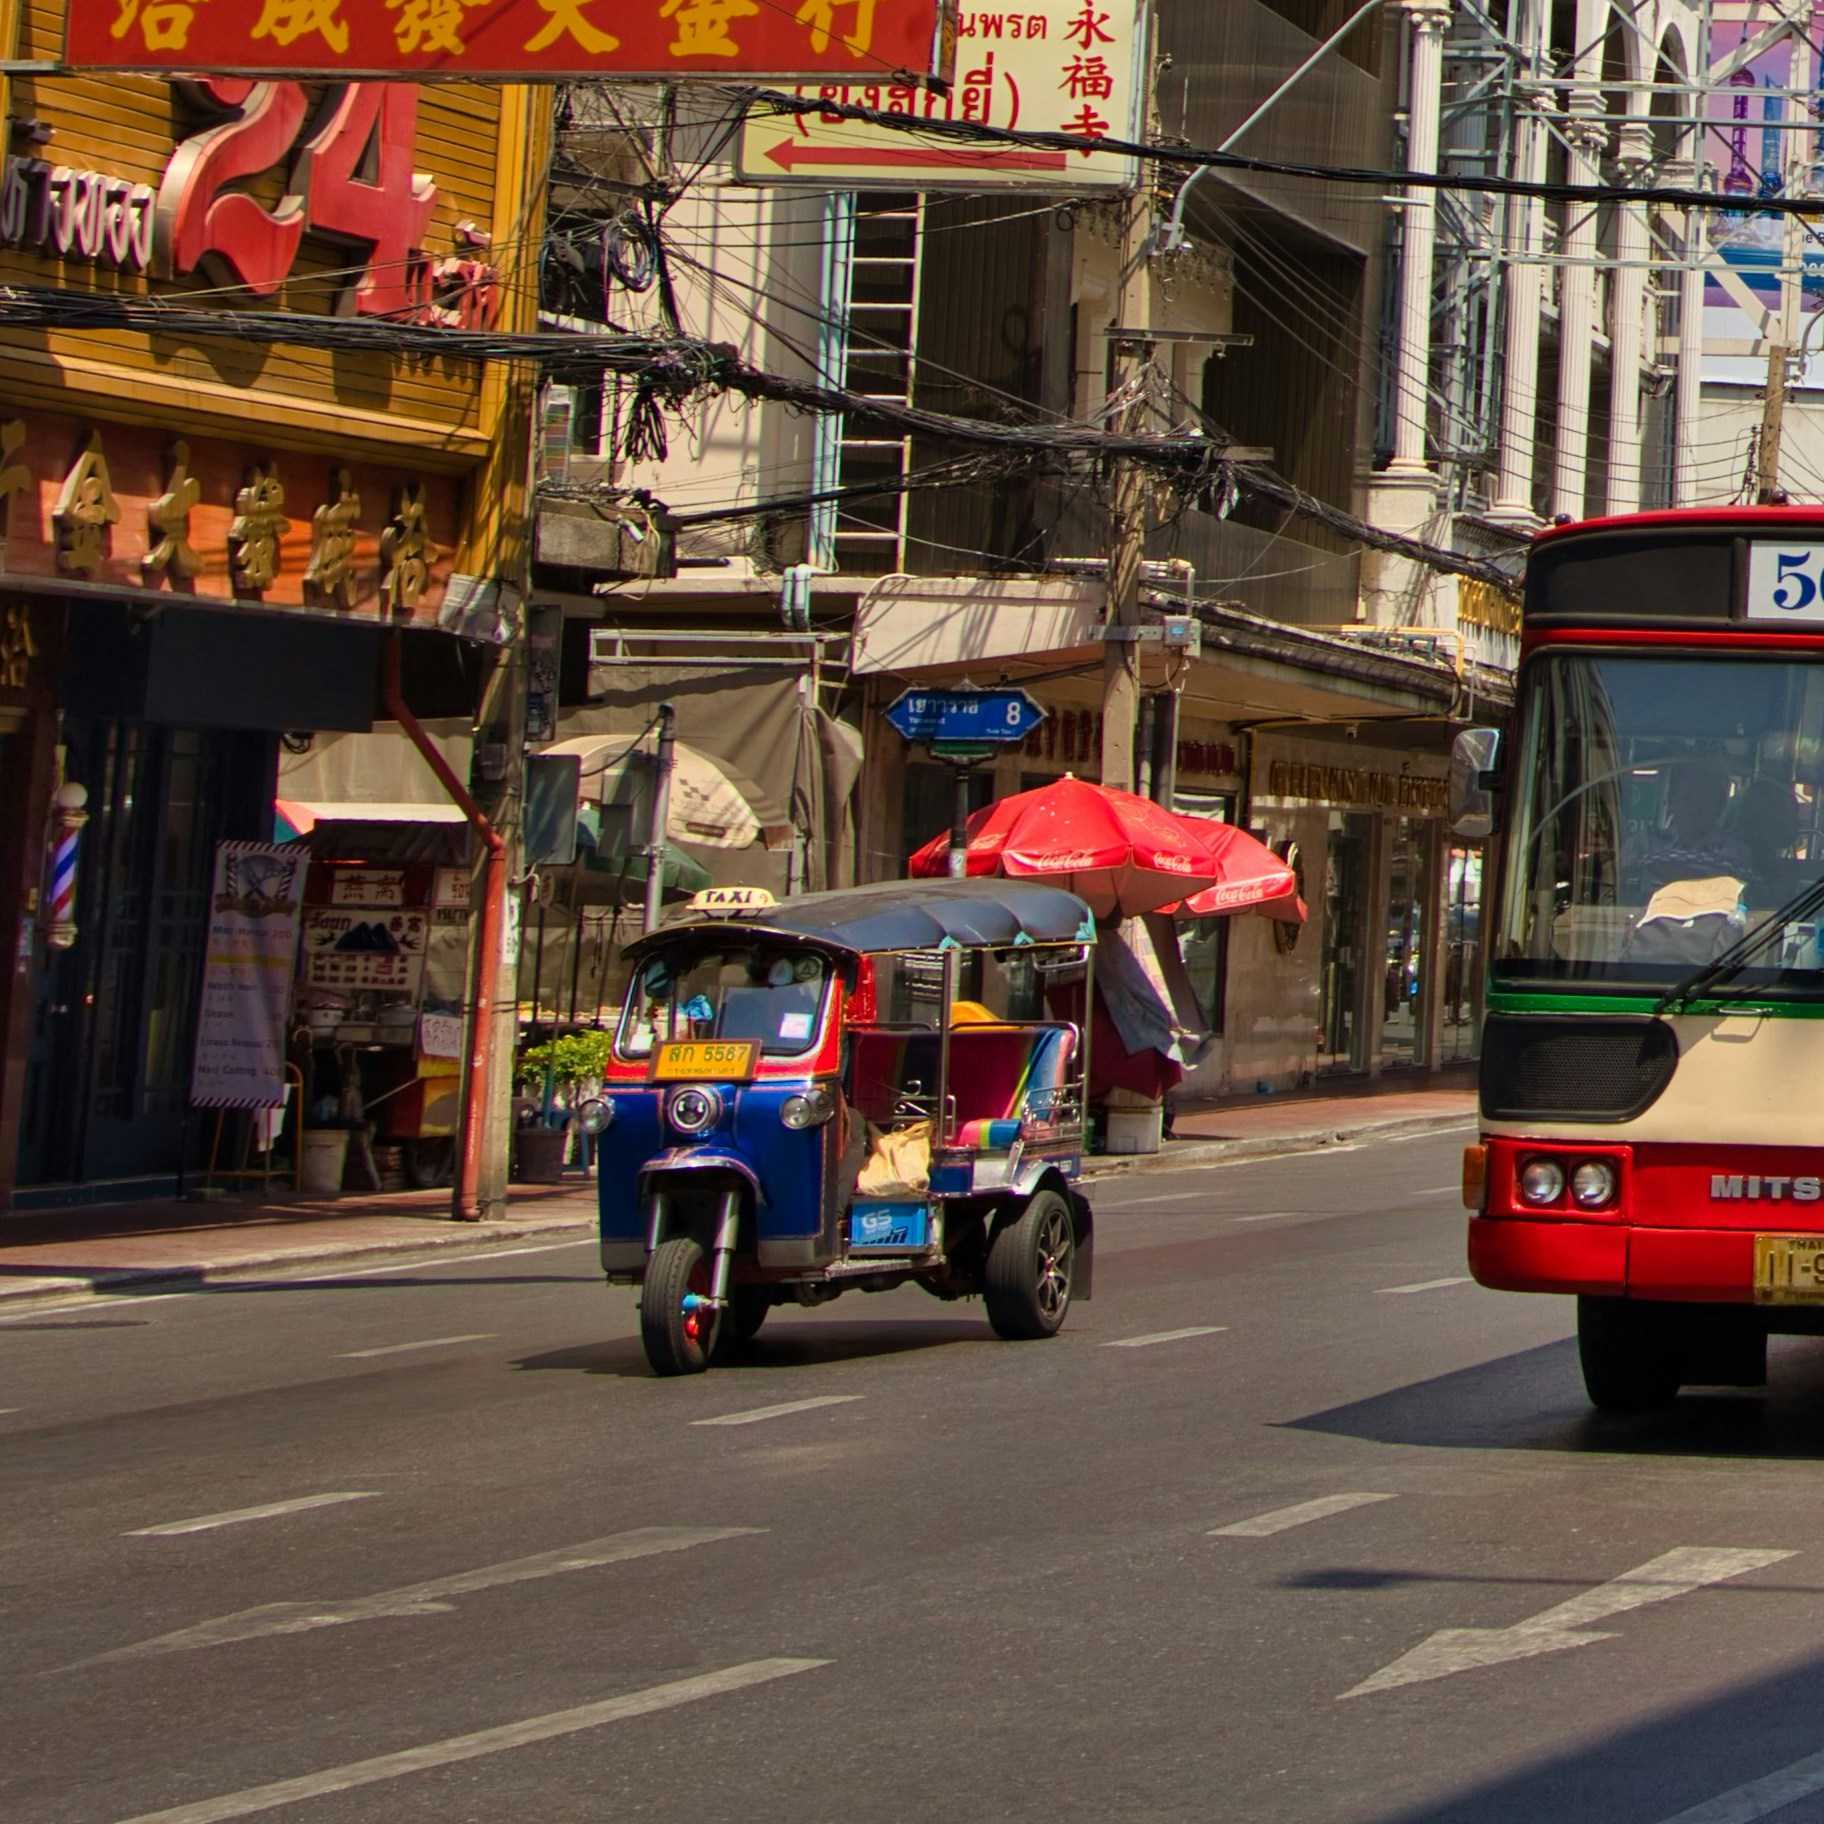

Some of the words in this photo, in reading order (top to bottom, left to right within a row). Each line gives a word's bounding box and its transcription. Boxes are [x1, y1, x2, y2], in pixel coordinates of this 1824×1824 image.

[1004, 701, 1022, 726] 8
[704, 889, 753, 904] TAXI
[703, 1045, 749, 1062] 5567
